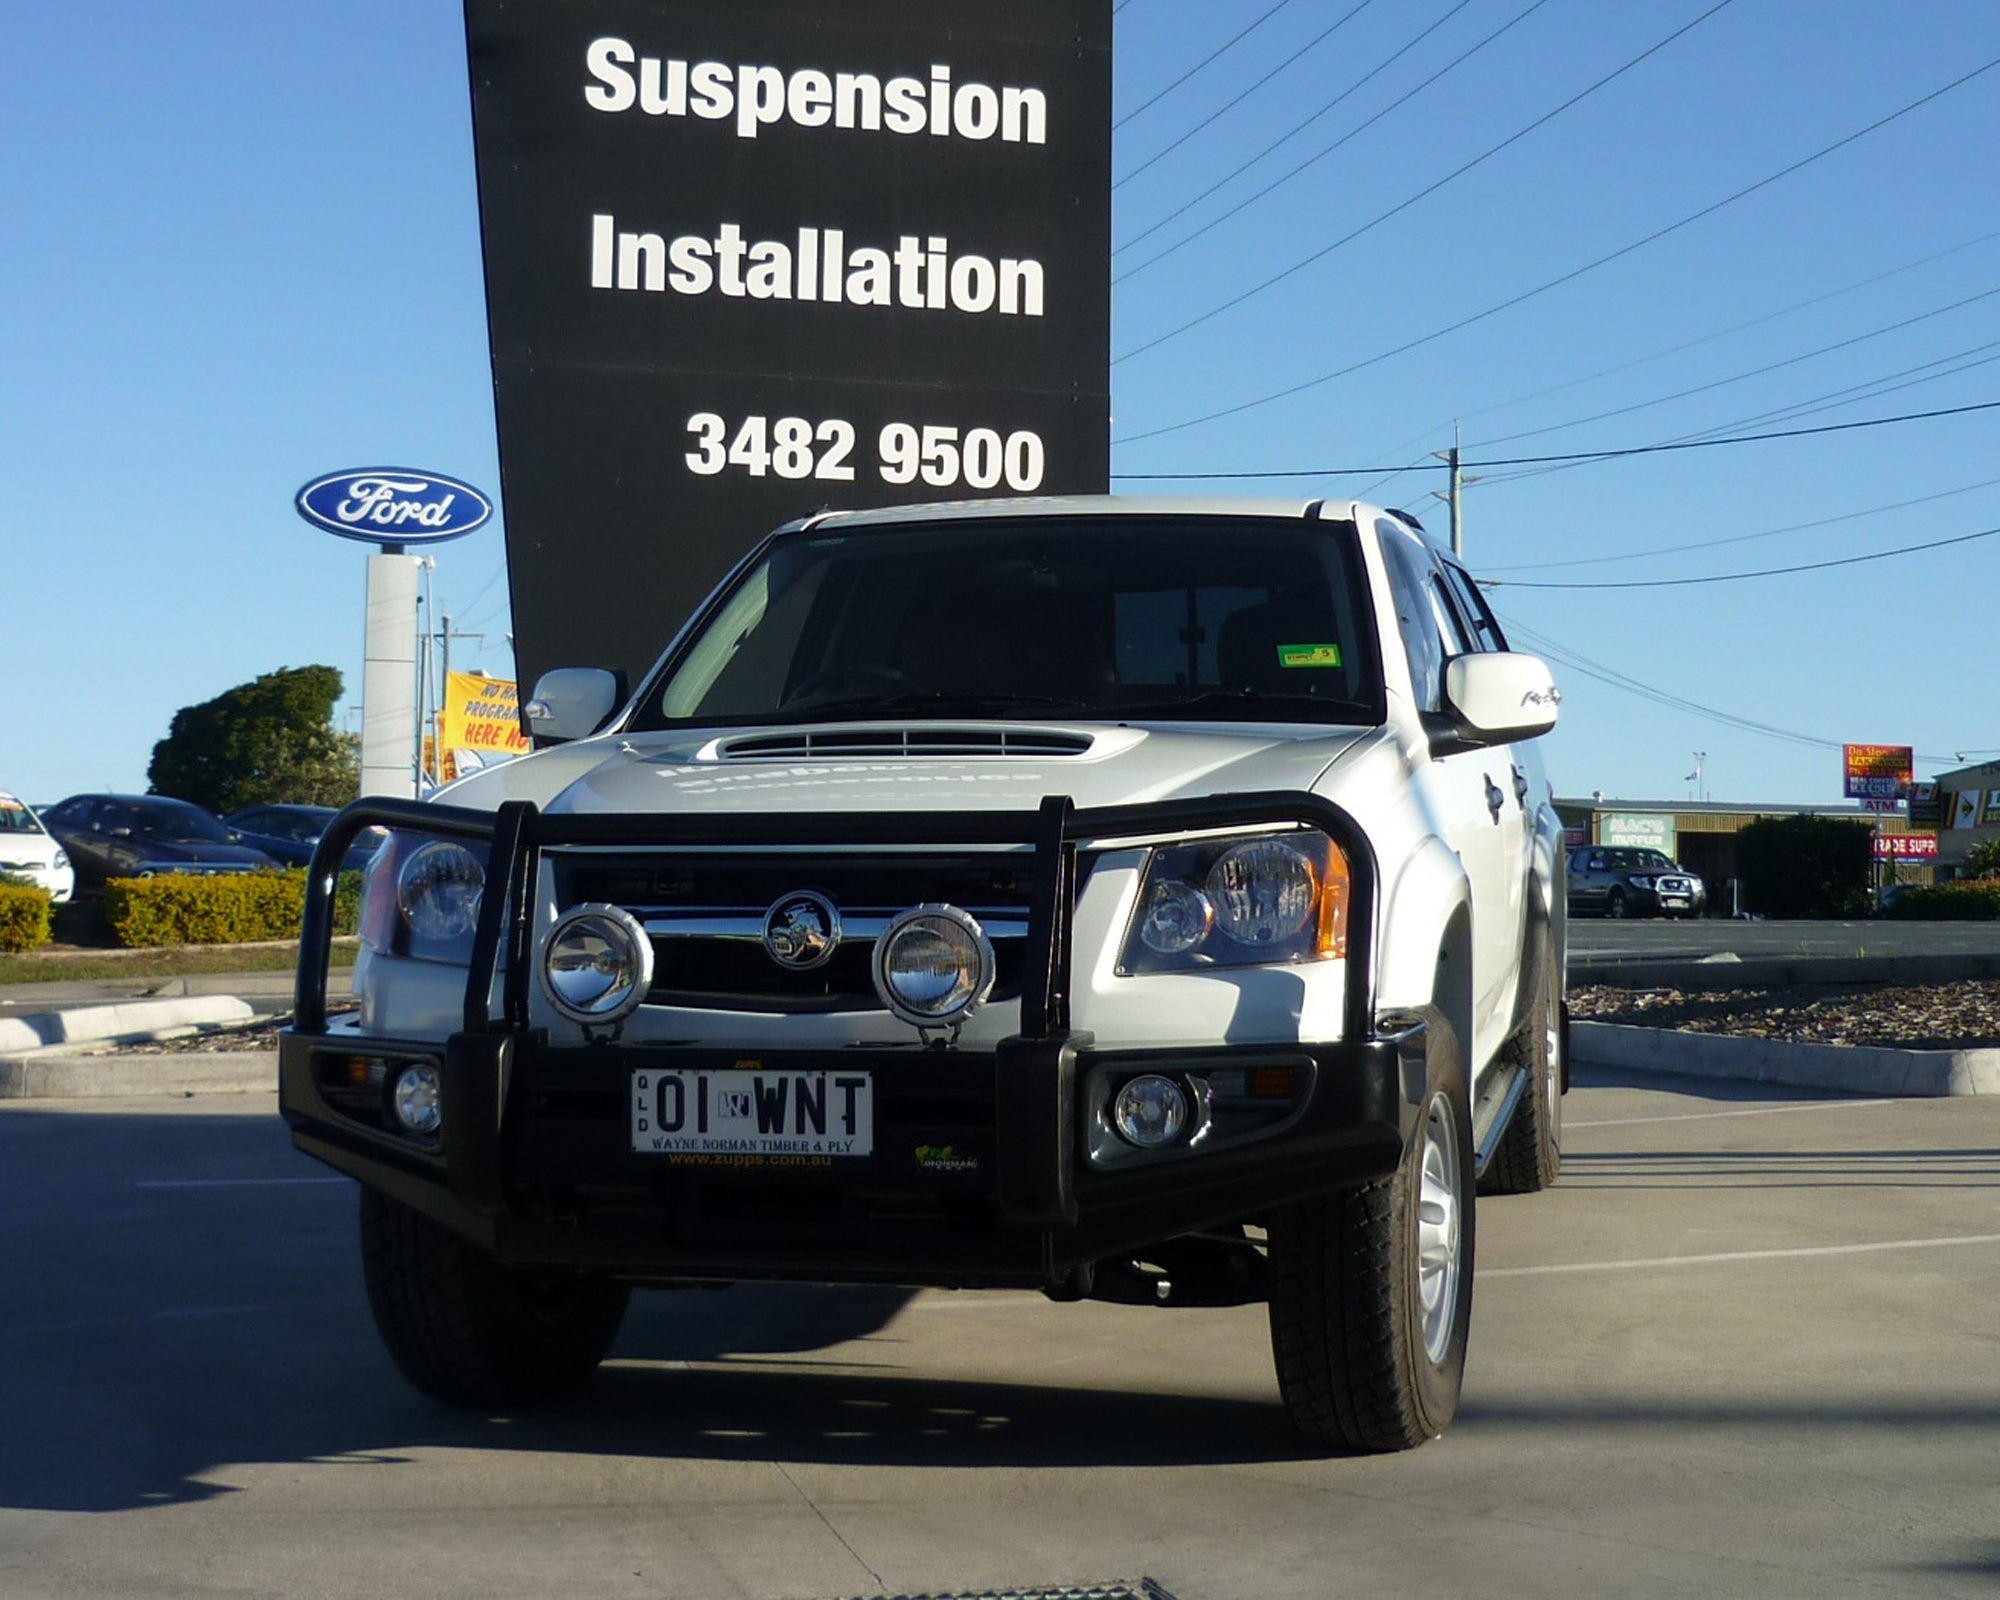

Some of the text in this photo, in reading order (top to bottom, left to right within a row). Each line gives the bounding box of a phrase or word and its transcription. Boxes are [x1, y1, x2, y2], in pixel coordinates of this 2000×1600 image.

[585, 37, 1046, 144] Suspension
[591, 214, 1044, 316] Installation
[685, 413, 1045, 491] 3482 9500
[337, 478, 455, 527] Ford
[480, 682, 501, 699] NO
[464, 722, 504, 745] HERE
[1866, 801, 1895, 810] ATM
[652, 1136, 854, 1153] WAYNE NORMAN TIMBER & PLY
[668, 1153, 832, 1168] www.zupps.com.au
